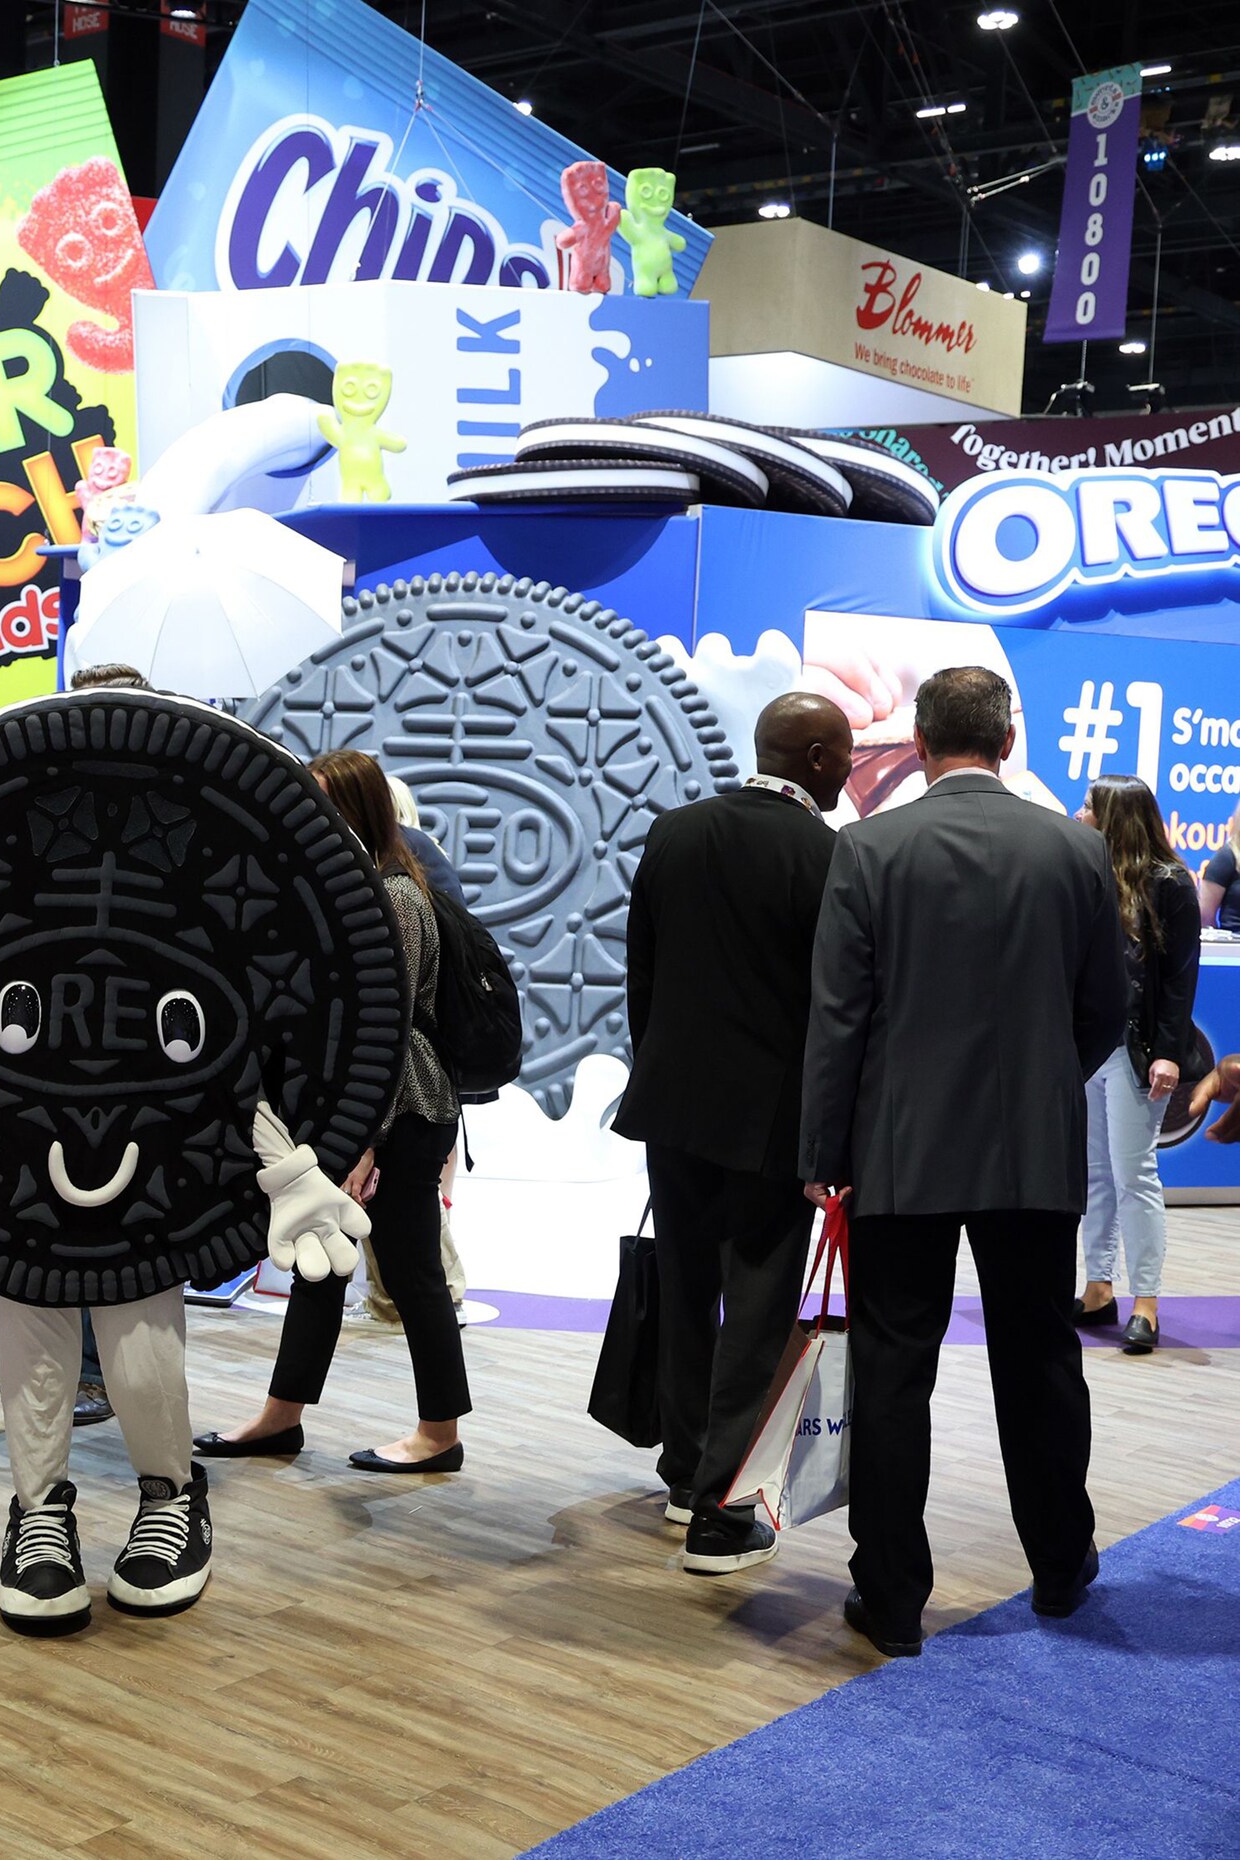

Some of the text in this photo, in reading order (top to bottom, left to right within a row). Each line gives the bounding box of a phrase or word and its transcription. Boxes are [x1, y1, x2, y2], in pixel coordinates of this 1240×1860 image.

[72, 12, 101, 33] HOSE
[1075, 133, 1108, 325] 10800
[856, 258, 978, 354] Blommer
[855, 342, 871, 362] We
[873, 347, 898, 376] bring
[900, 359, 944, 386] chocolate
[946, 372, 956, 389] to
[949, 423, 1096, 475] Together!
[953, 479, 1240, 597] ORE
[1058, 680, 1163, 796] #1
[795, 1417, 822, 1437] ARS
